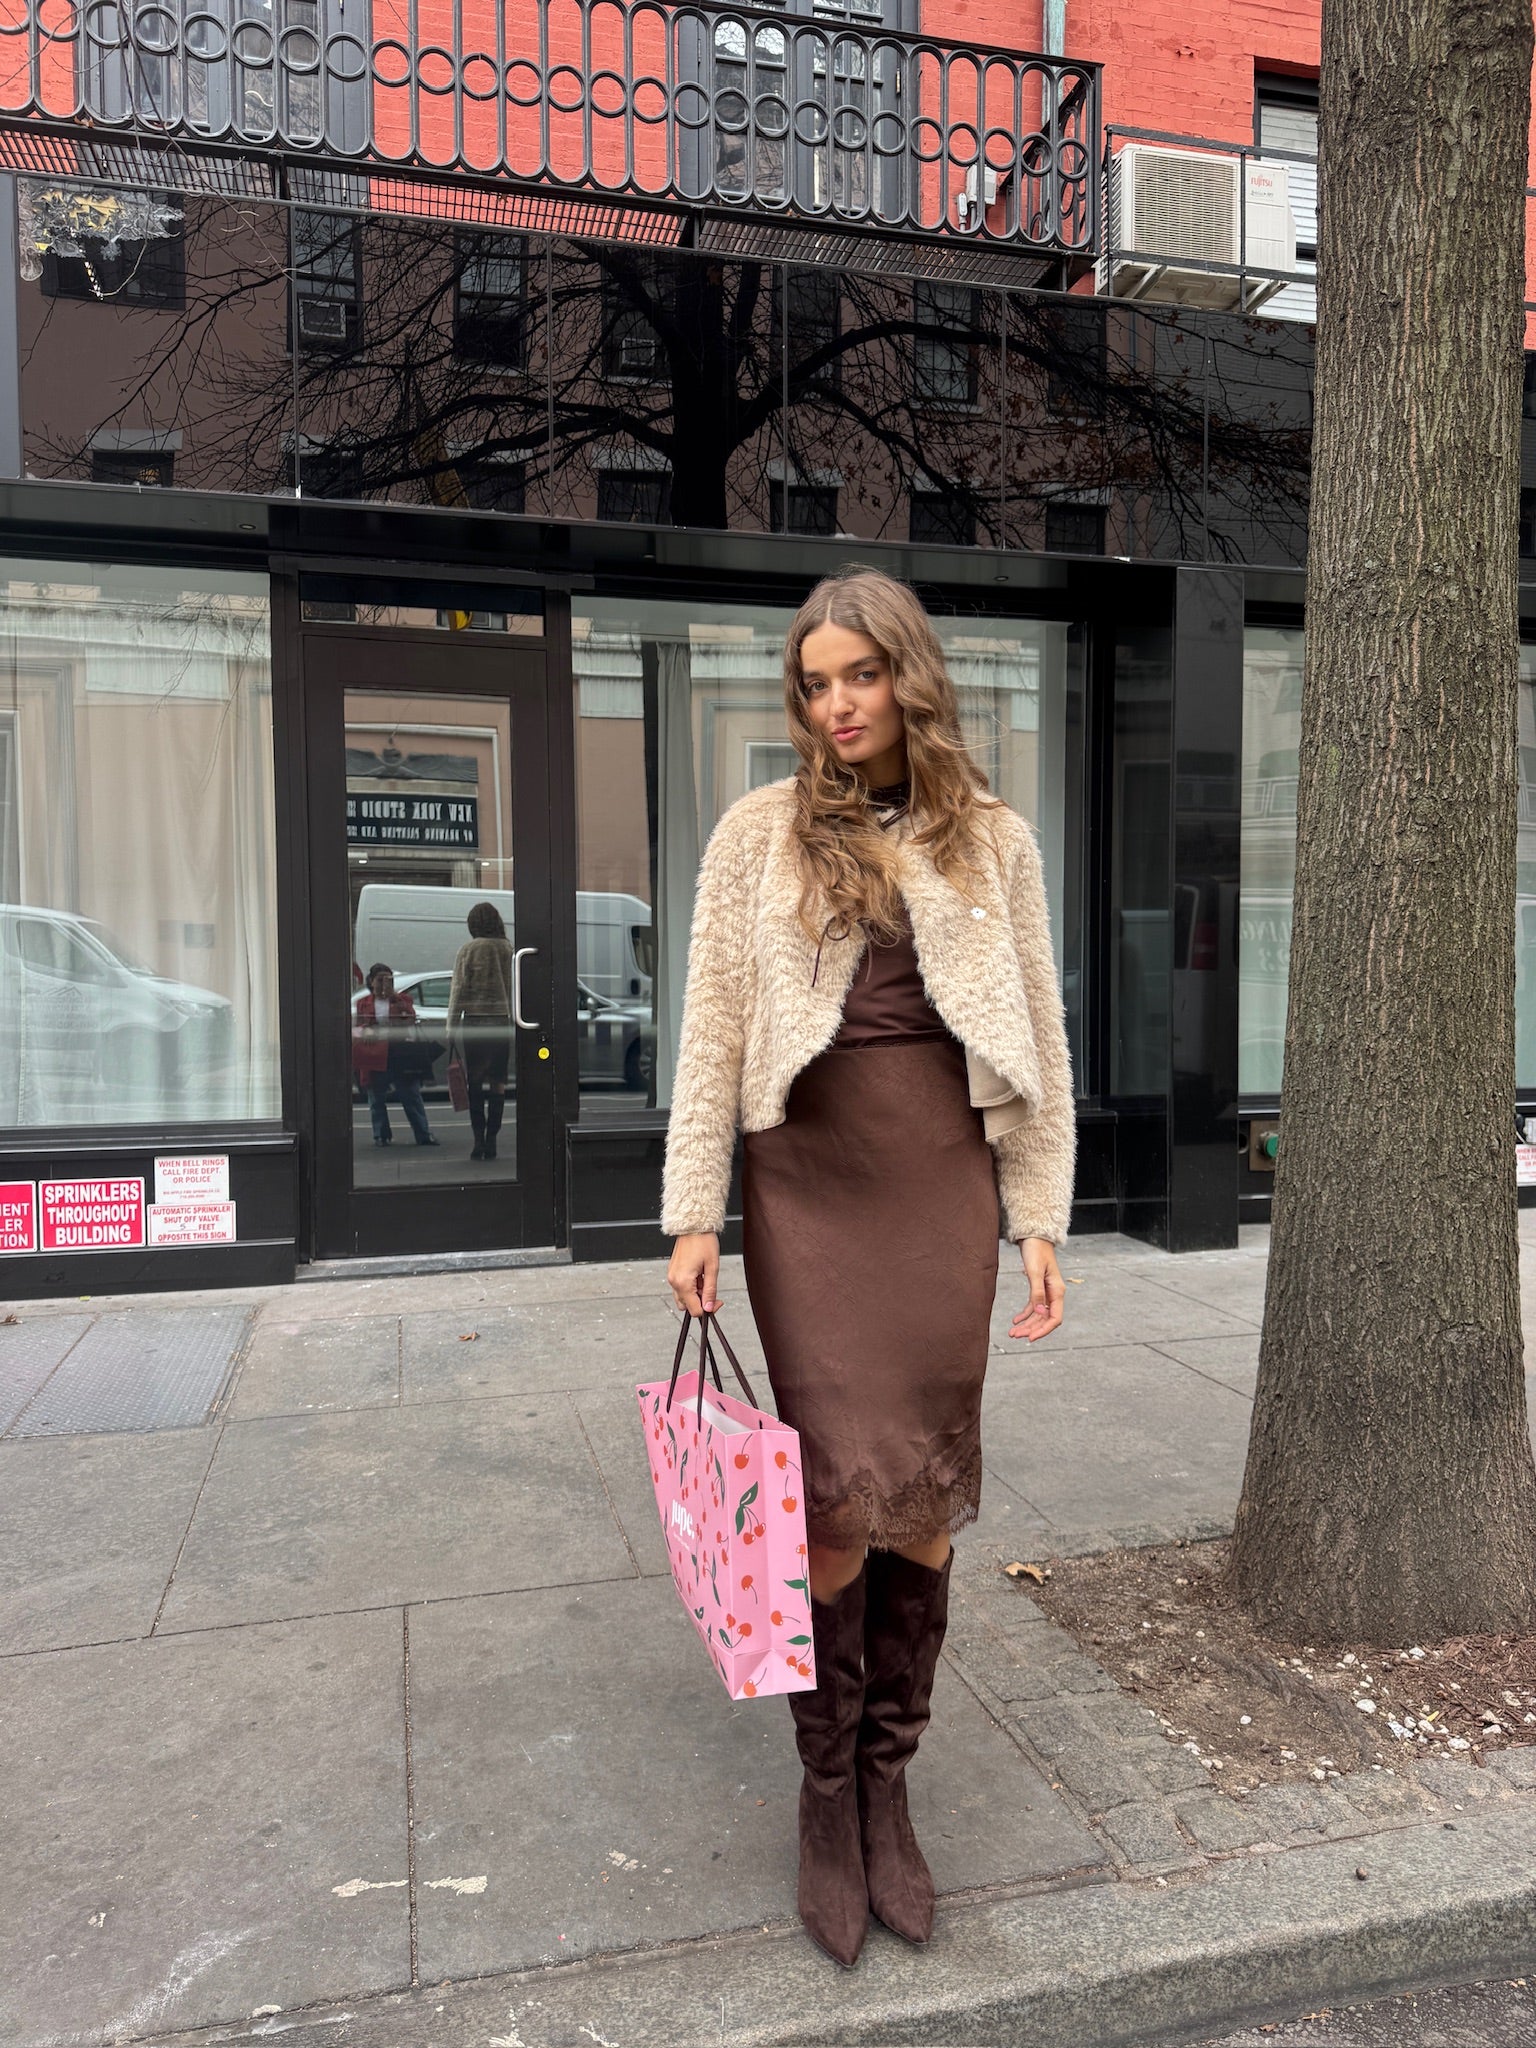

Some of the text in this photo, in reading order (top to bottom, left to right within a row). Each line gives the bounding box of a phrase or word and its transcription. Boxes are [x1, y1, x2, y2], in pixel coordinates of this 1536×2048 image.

[182, 1159, 200, 1167] BELL
[202, 1158, 225, 1166] RINGS
[45, 1182, 139, 1204] SPRINKLERS
[0, 1203, 29, 1217] ENT
[47, 1204, 137, 1225] THROUGHOUT
[153, 1206, 230, 1215] AUTOMATIC SPRINKLER
[0, 1219, 23, 1232] ER
[164, 1216, 182, 1224] SHUT
[56, 1224, 130, 1245] BUILDING
[158, 1233, 191, 1241] OPPOSITE
[210, 1231, 226, 1239] SIGN
